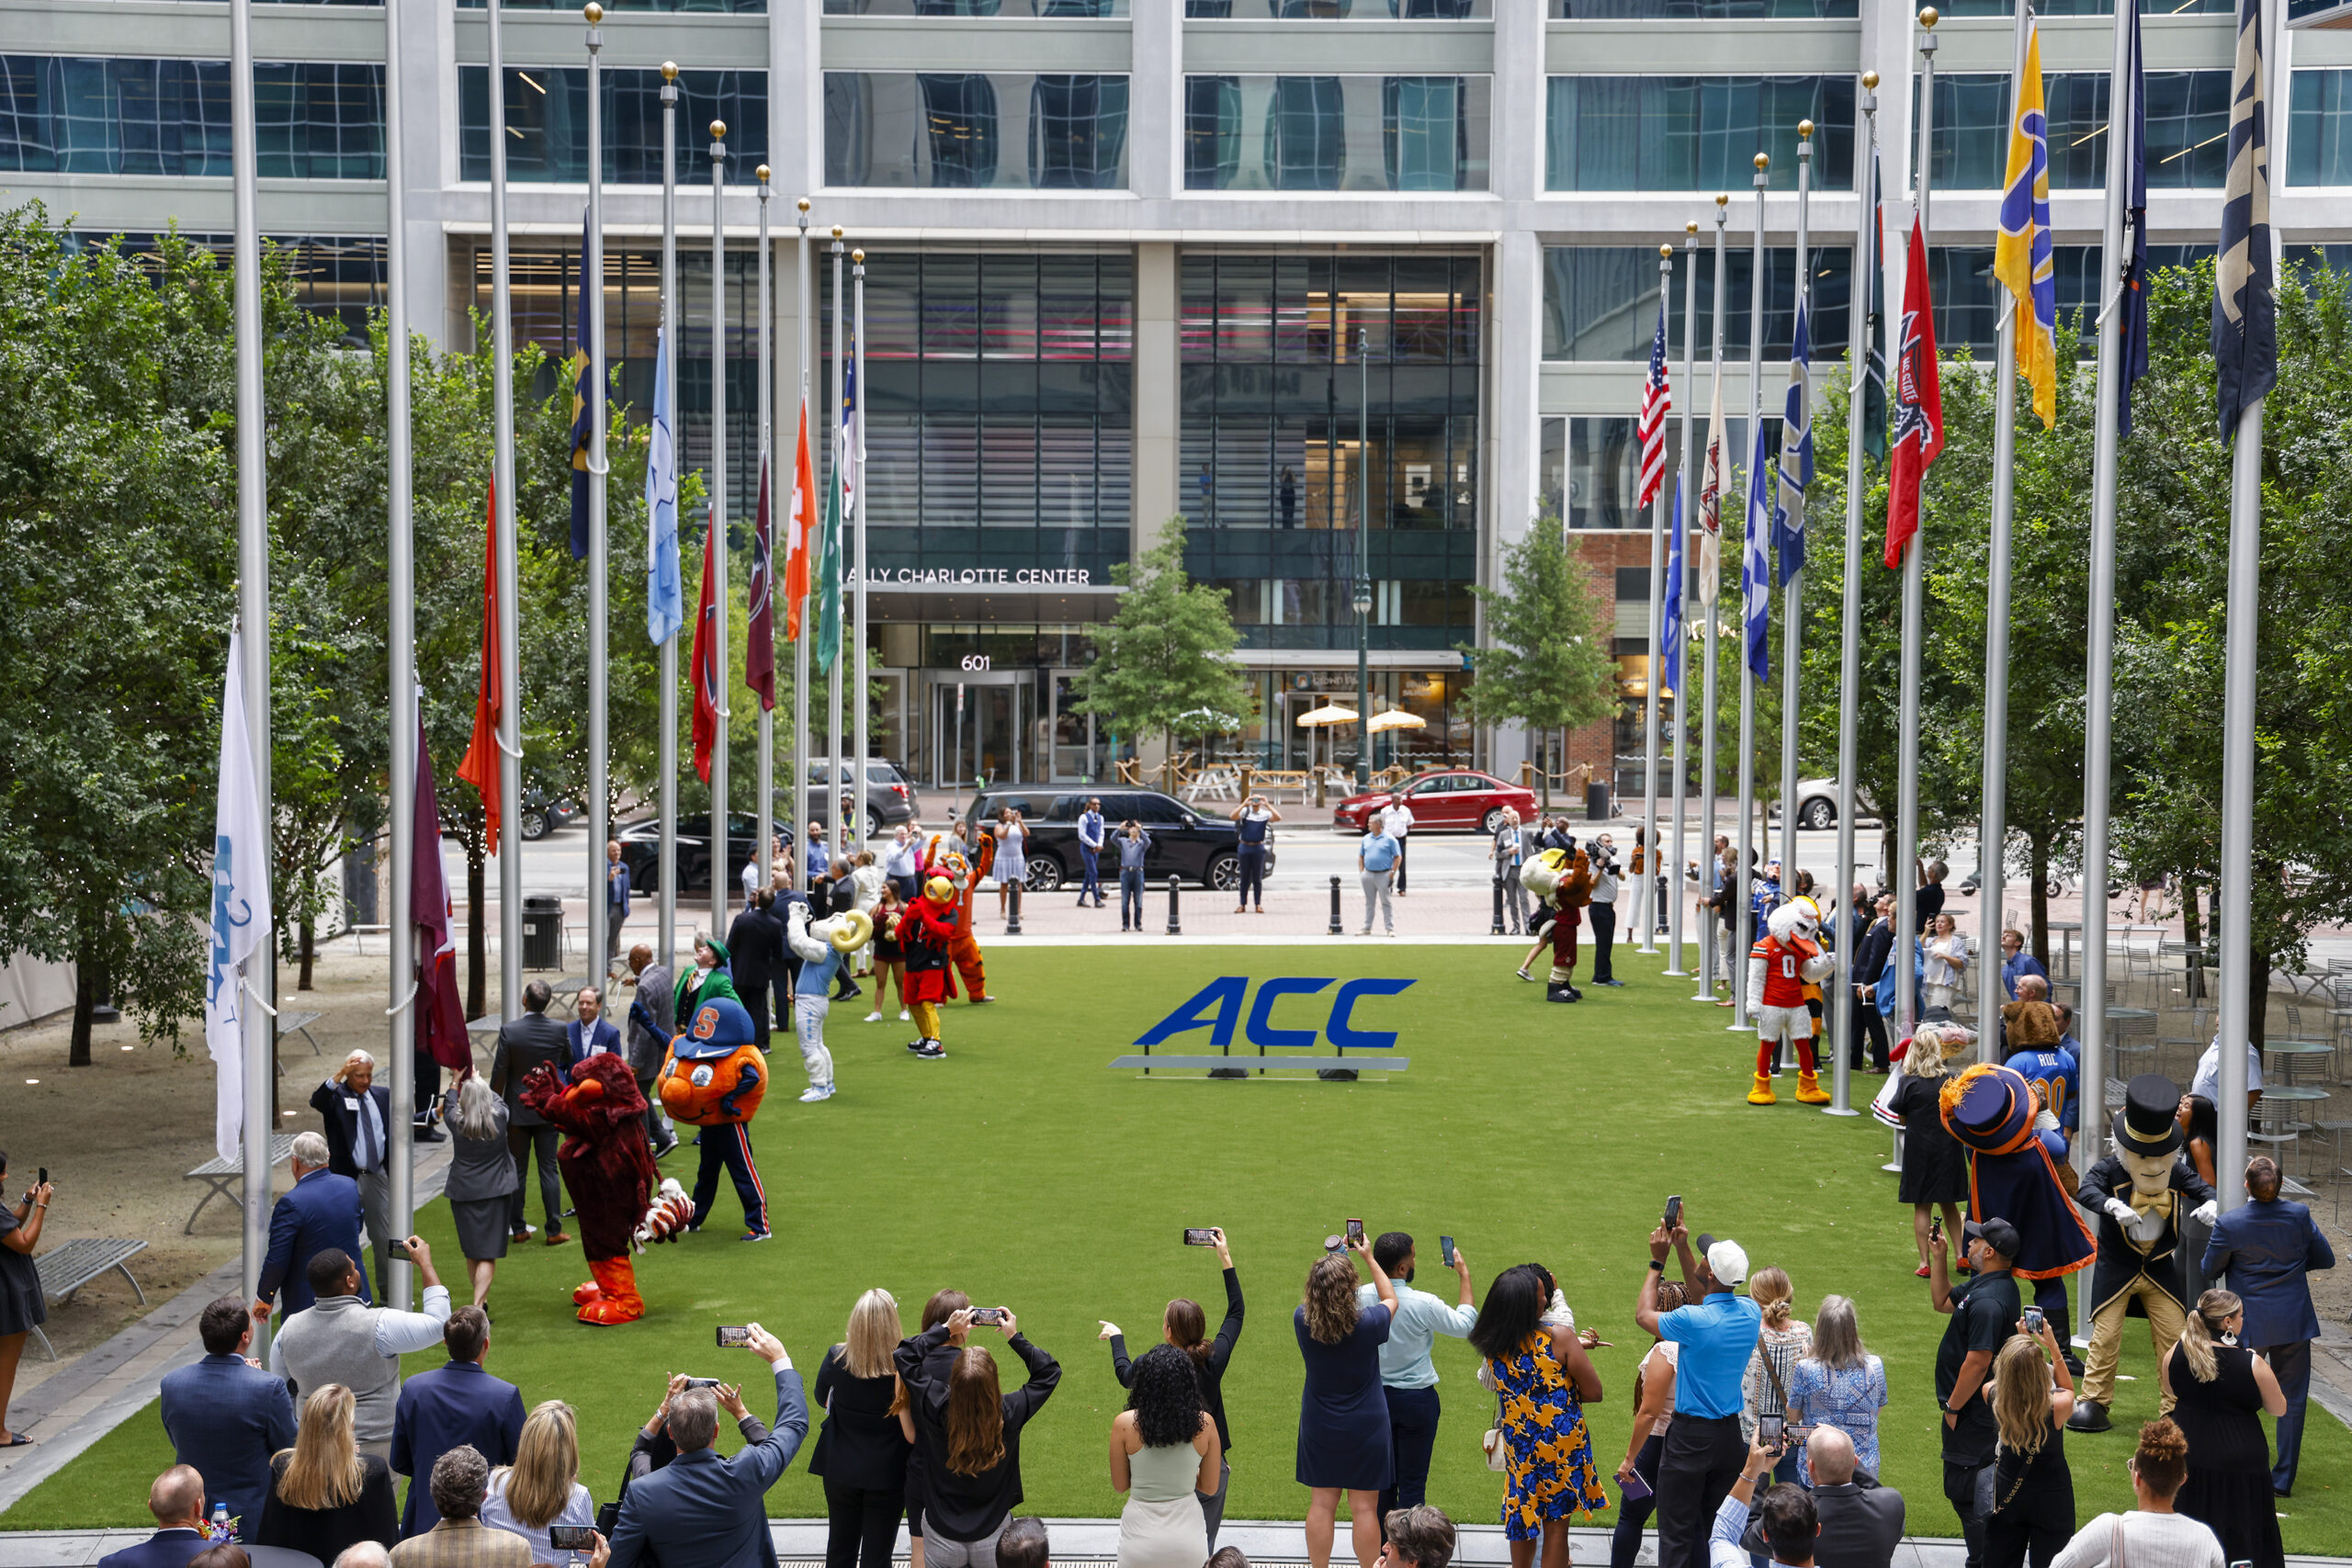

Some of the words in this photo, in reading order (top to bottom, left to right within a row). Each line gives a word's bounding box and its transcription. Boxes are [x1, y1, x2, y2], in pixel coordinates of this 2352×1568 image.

[1902, 356, 1911, 373] NC
[1902, 372, 1919, 402] STATE
[898, 568, 1008, 584] CHARLOTTE
[1016, 569, 1090, 585] CENTER
[961, 655, 990, 671] 601
[1782, 954, 1796, 979] 0
[1131, 976, 1419, 1048] ACC
[693, 1006, 720, 1040] S
[2037, 1053, 2059, 1067] ROC
